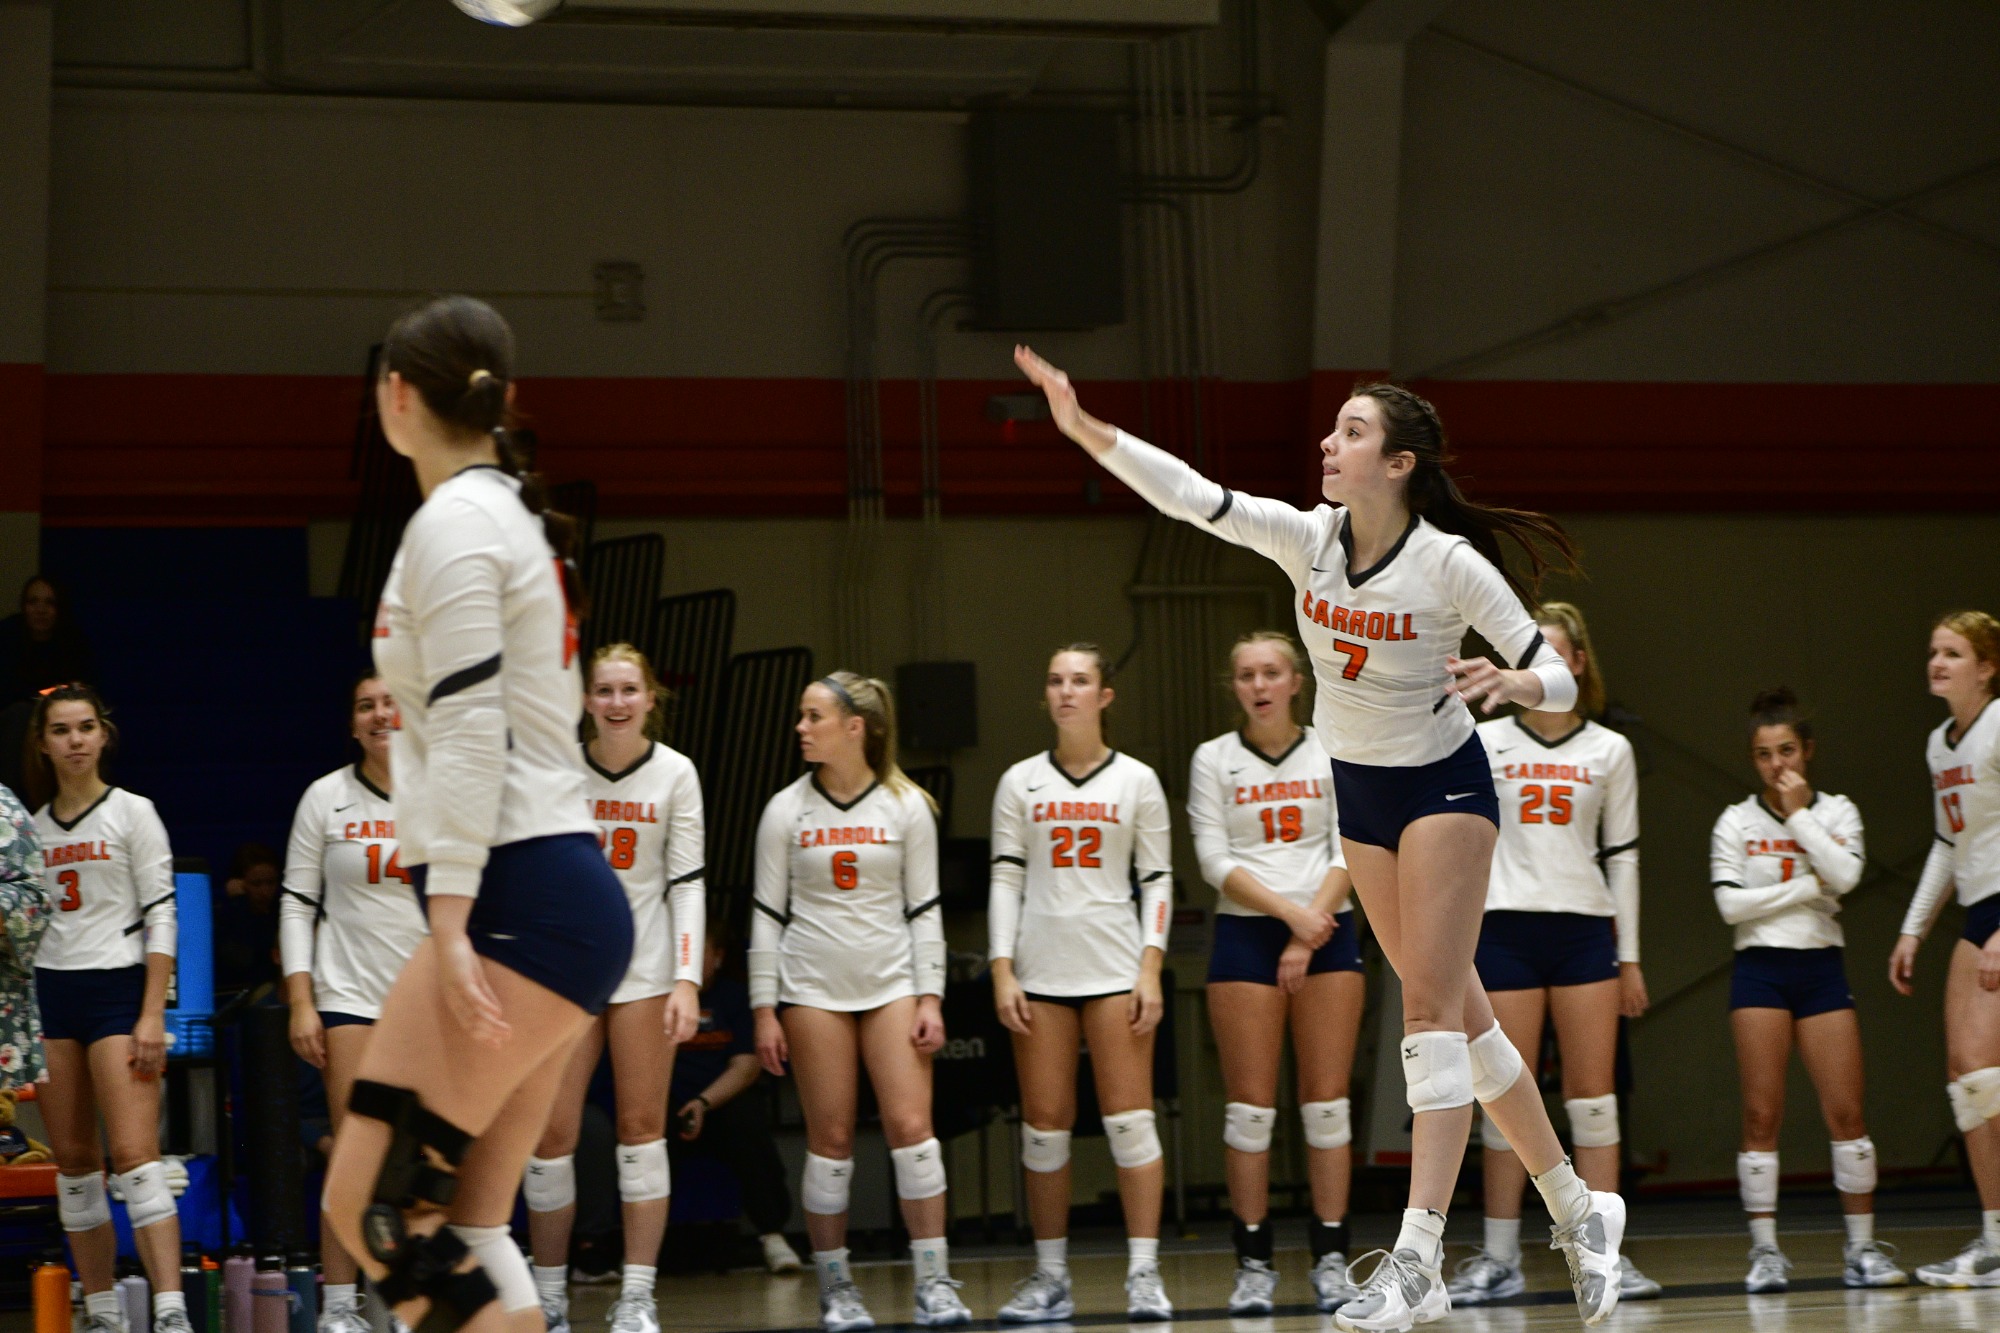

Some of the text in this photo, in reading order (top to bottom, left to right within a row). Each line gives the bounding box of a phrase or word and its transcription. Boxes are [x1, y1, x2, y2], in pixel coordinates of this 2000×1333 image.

[1303, 590, 1418, 641] CARROLL
[1333, 638, 1368, 681] 7
[1235, 779, 1322, 805] CARROLL
[1504, 763, 1593, 785] CARROLL
[585, 799, 658, 824] RROLL
[1033, 801, 1120, 824] CARROLL
[1259, 805, 1302, 843] 18
[1520, 784, 1573, 825] 25
[800, 826, 888, 848] CARROLL
[1050, 826, 1102, 868] 22
[366, 844, 413, 884] 14
[831, 851, 858, 890] 6
[57, 869, 82, 911] 3
